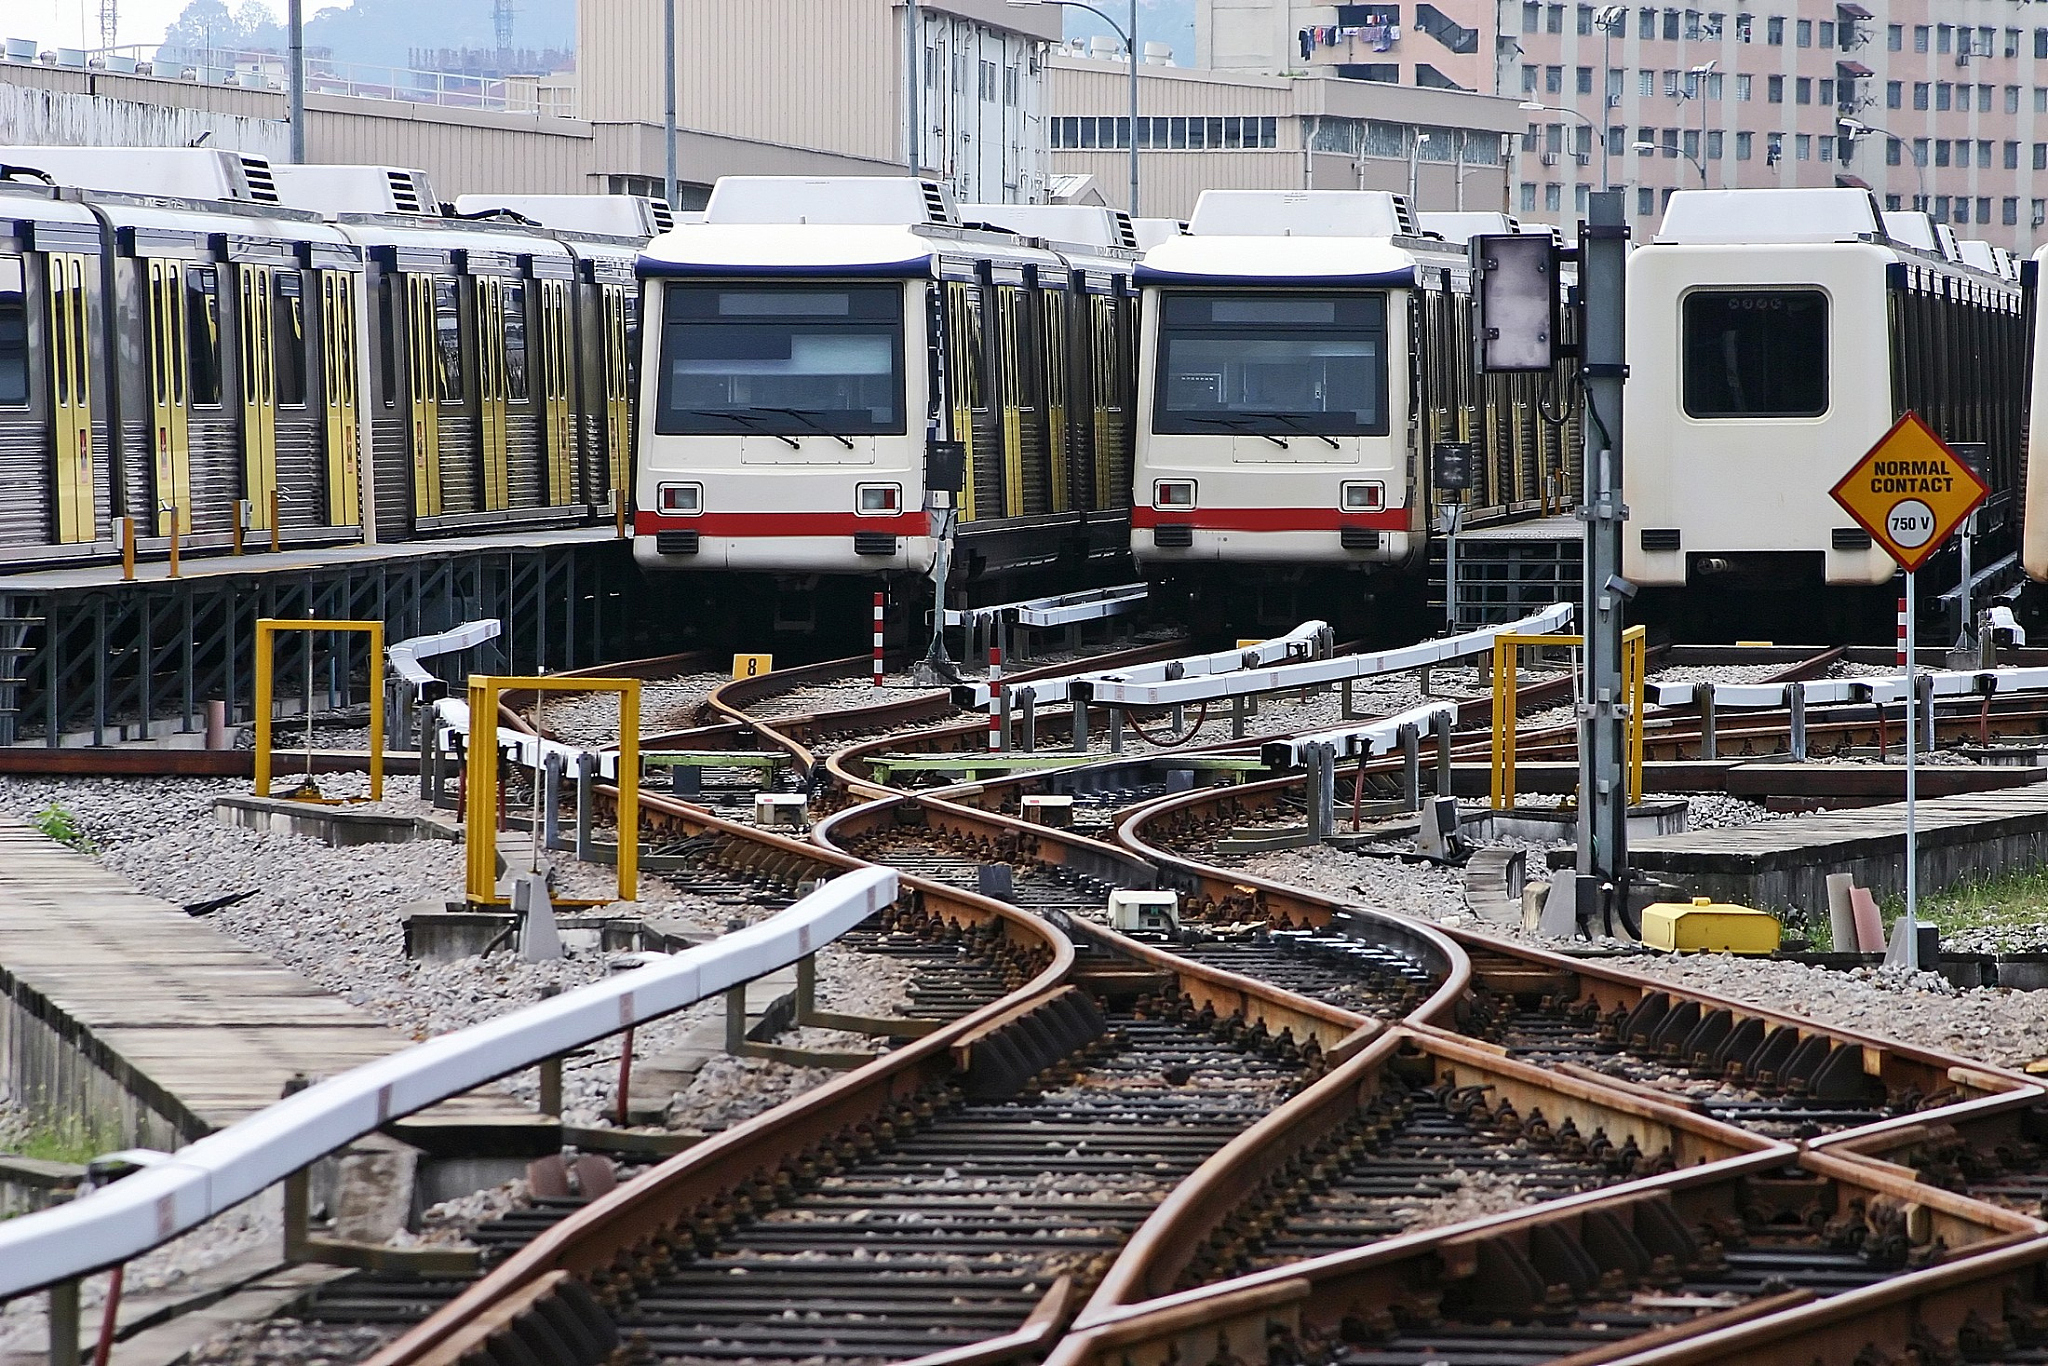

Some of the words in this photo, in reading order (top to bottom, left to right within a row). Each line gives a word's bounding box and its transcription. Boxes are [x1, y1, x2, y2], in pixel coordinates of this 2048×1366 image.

[1874, 461, 1950, 476] NORMAL
[1871, 477, 1954, 493] CONTACT
[1892, 517, 1916, 531] 750
[1920, 516, 1930, 530] V
[747, 658, 757, 676] 8
